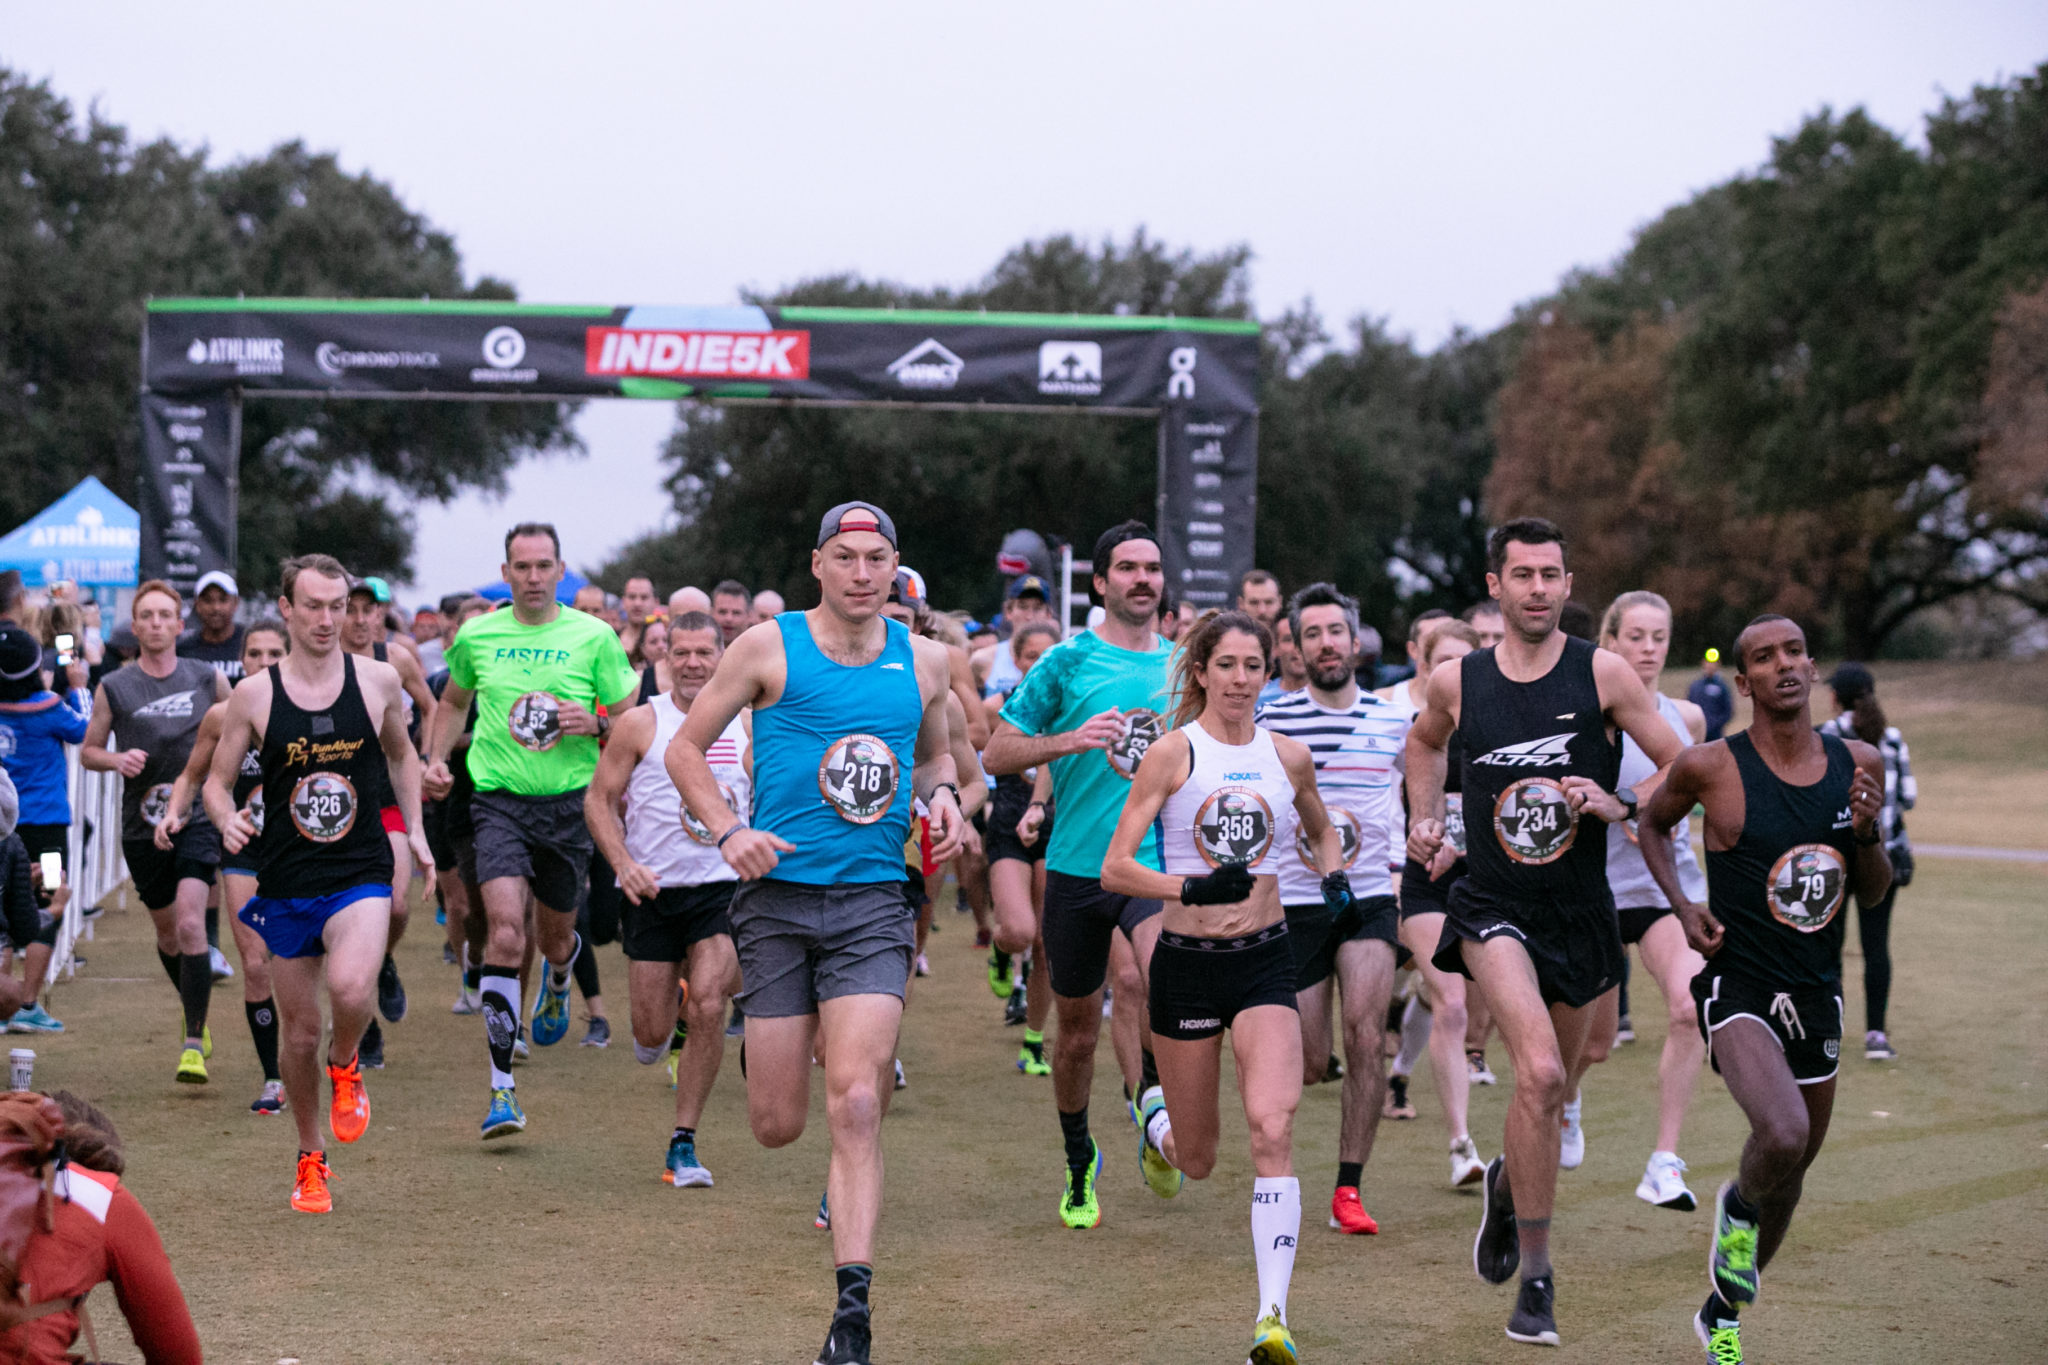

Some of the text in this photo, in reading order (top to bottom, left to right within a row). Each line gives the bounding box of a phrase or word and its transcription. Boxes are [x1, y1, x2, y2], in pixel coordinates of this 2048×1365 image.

[208, 337, 284, 362] ATHLINKS
[598, 331, 799, 375] INDIE5K
[494, 647, 570, 665] FASTER
[528, 710, 548, 730] 52
[311, 738, 364, 754] RunAbout
[1127, 728, 1151, 760] 281
[316, 751, 354, 764] Sports
[1472, 753, 1571, 767] ALTRA
[843, 761, 882, 793] 218
[1223, 772, 1250, 781] HOKA
[308, 794, 341, 817] 326
[1218, 814, 1254, 841] 358
[1517, 805, 1558, 833] 234
[1798, 874, 1825, 902] 79
[1179, 1018, 1211, 1030] HOKA
